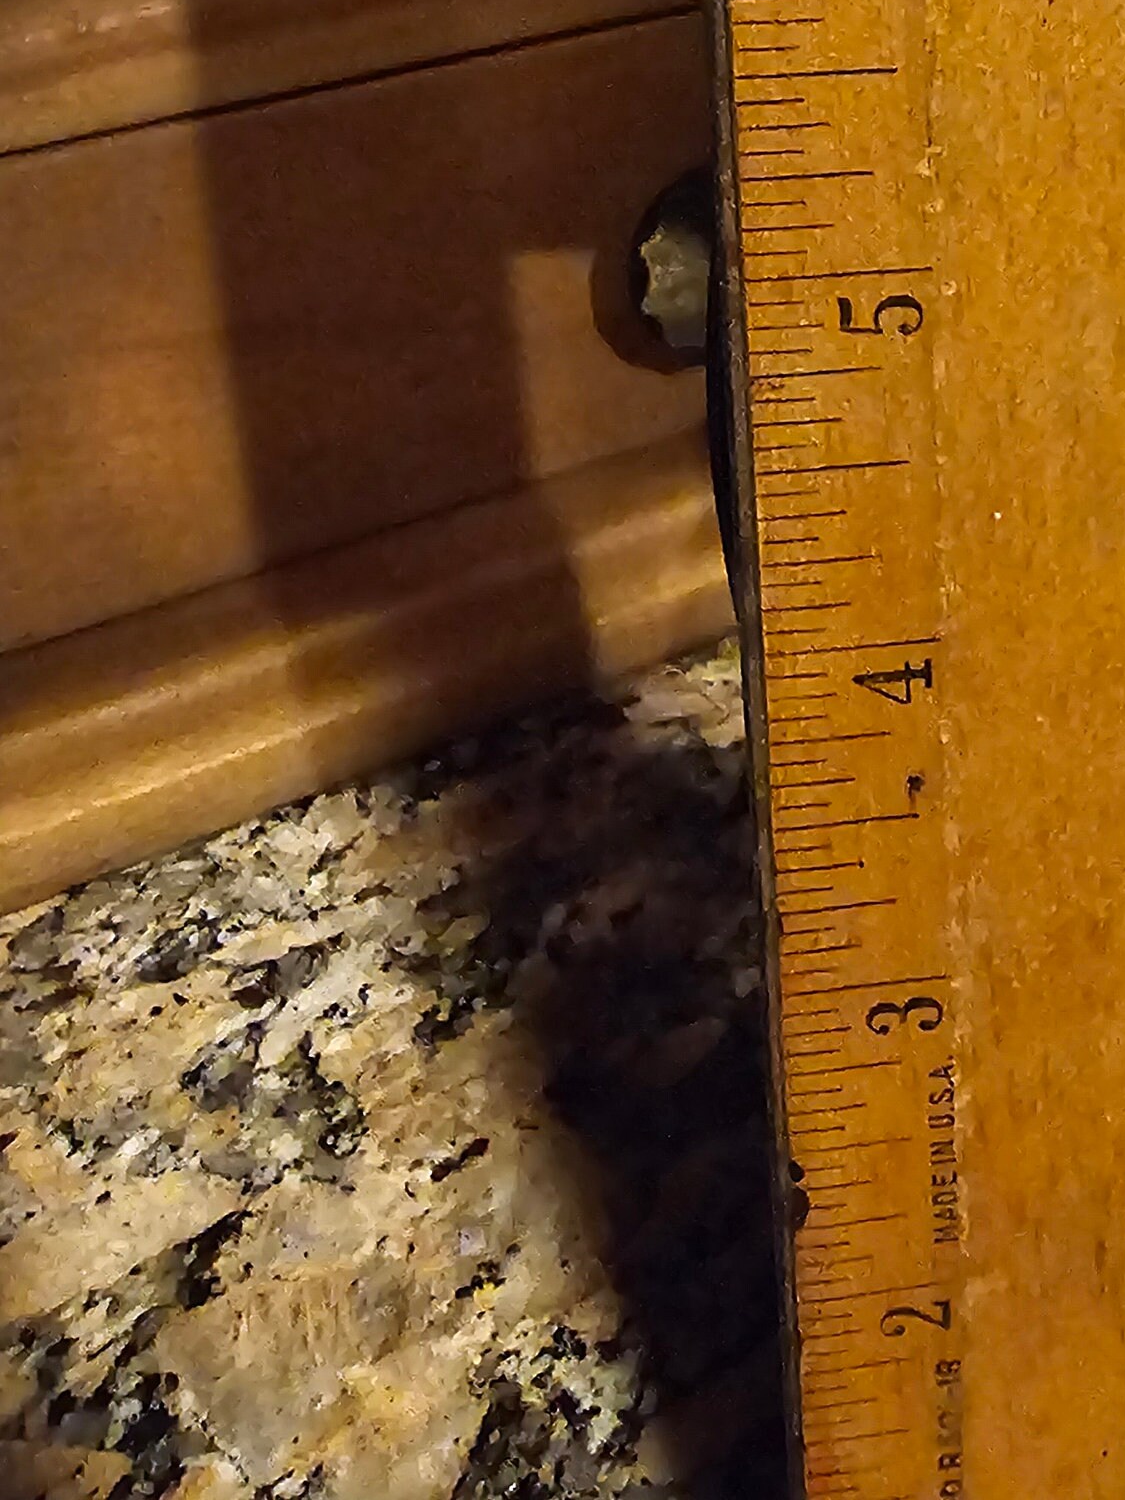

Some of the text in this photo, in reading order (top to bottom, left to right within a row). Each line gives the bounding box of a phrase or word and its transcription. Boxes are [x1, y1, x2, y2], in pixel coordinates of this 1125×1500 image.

[838, 294, 924, 336] 5
[852, 658, 933, 705] 4
[865, 996, 944, 1036] 3
[927, 1055, 960, 1245] MADE IN U.S.A.
[880, 1298, 952, 1337] 2
